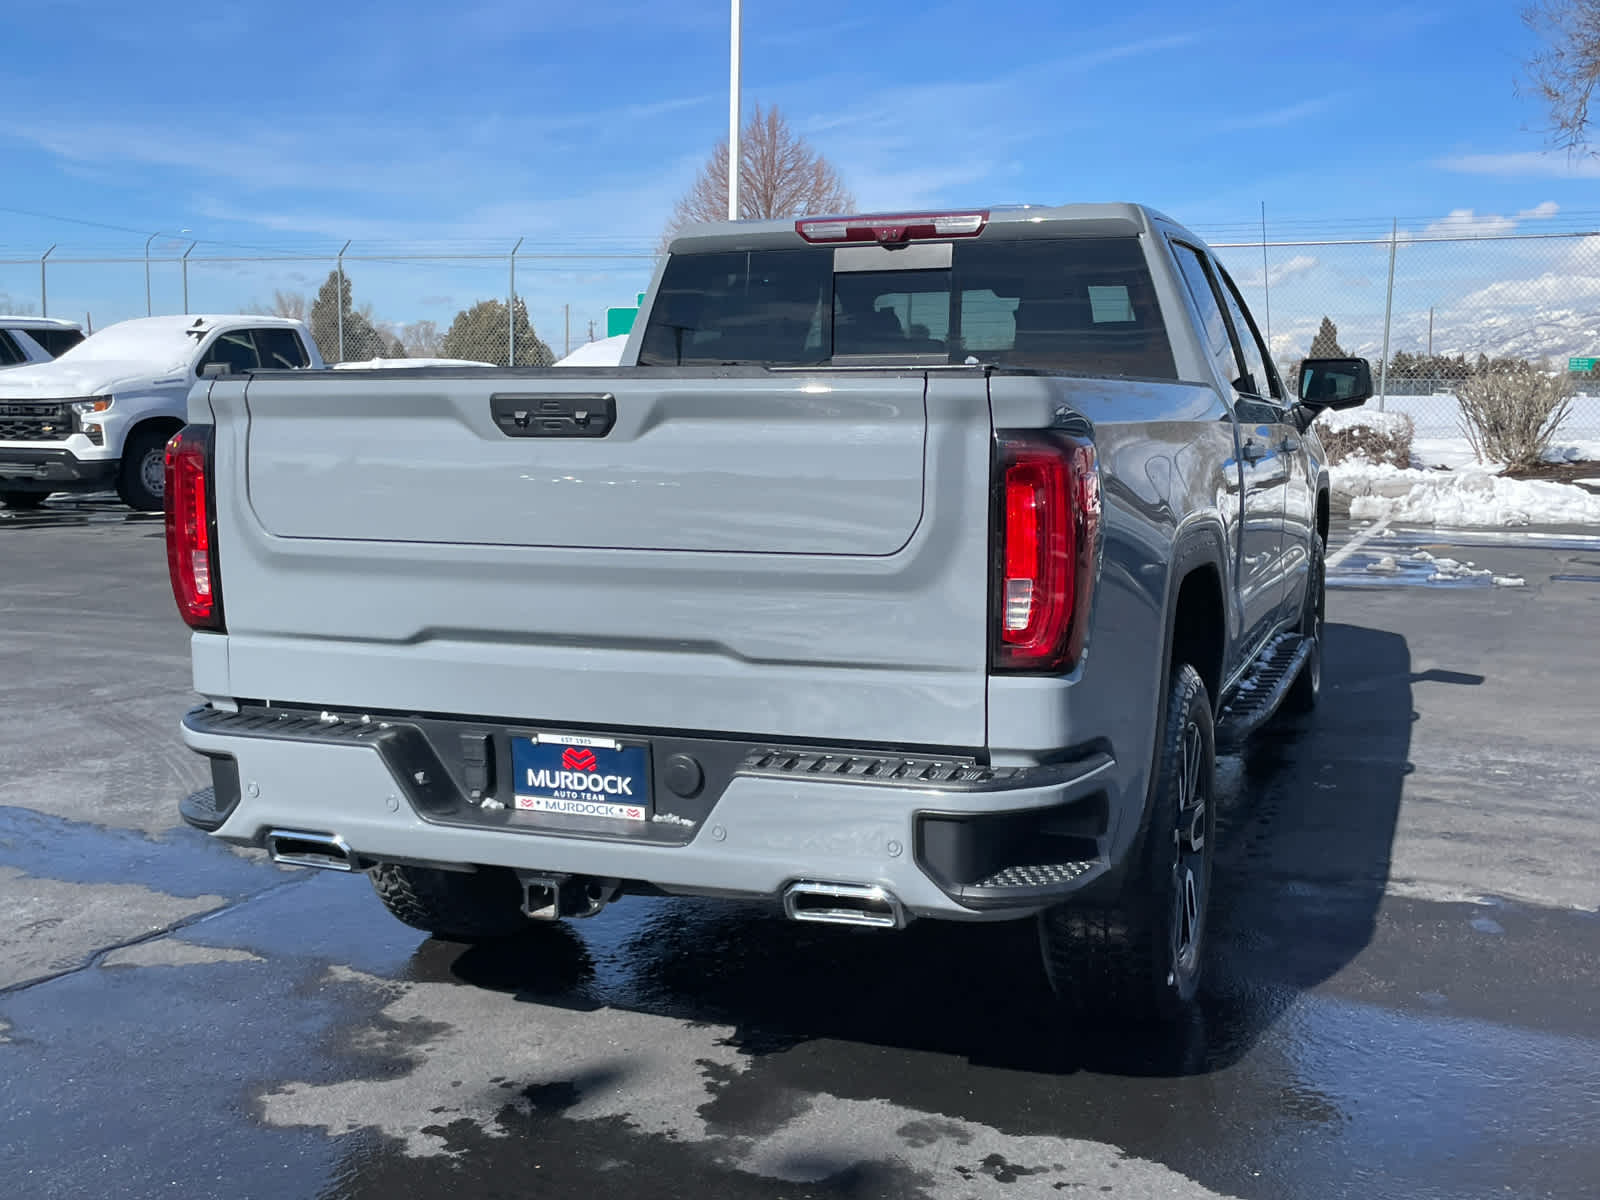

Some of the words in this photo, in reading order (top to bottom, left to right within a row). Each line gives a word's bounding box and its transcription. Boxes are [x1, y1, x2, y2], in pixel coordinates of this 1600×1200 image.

[527, 768, 632, 795] MURDOCK
[554, 790, 577, 799] AUTO
[581, 793, 605, 801] TEAM
[545, 801, 614, 815] MURDOCK
